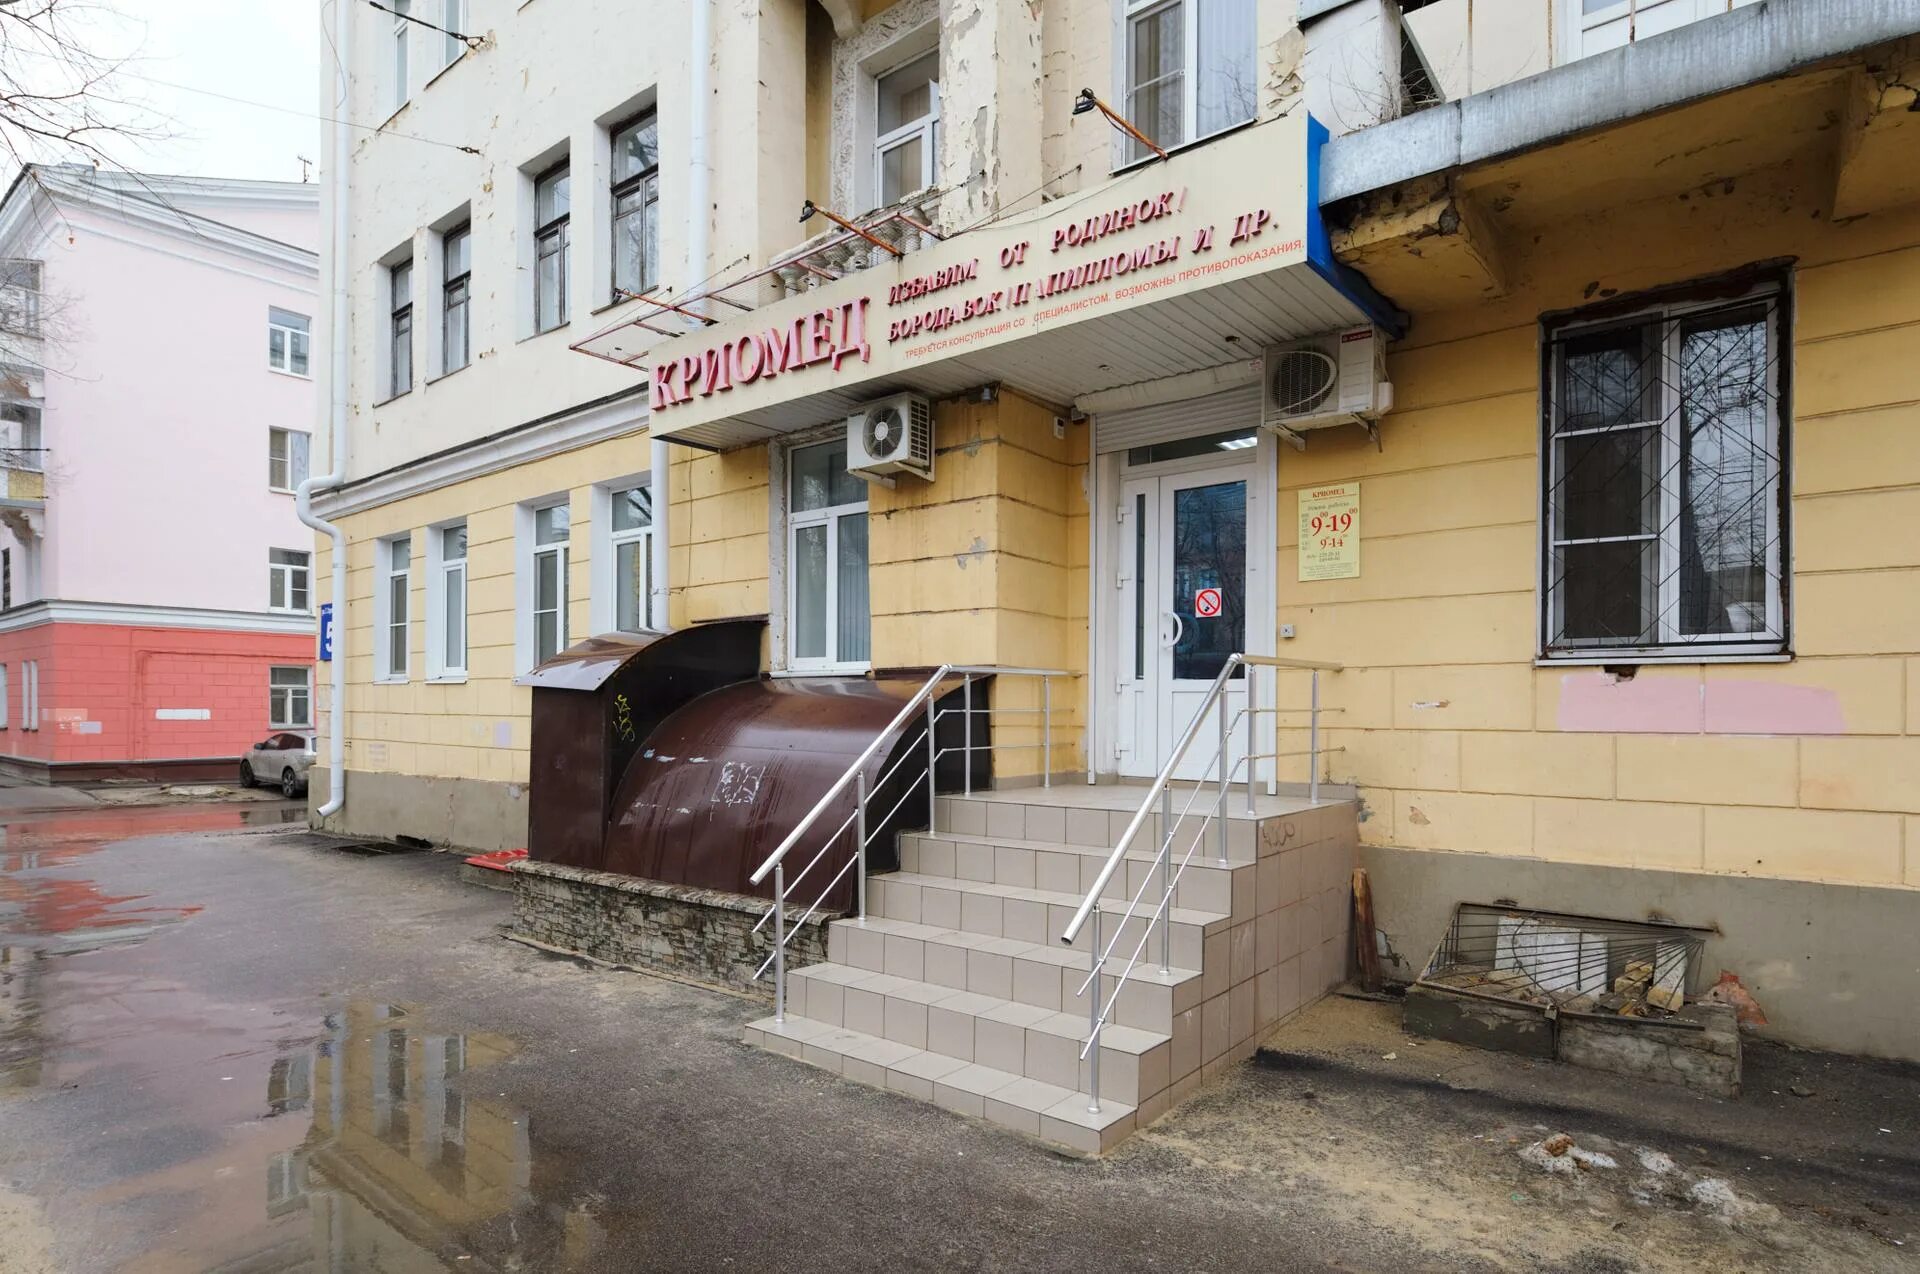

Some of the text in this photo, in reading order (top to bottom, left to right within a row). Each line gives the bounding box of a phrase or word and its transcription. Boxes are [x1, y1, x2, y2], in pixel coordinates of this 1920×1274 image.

[1192, 225, 1215, 255] И
[1229, 209, 1279, 247] ДР.
[888, 257, 979, 307] ИЗБАВИМ
[999, 241, 1031, 269] ОТ
[650, 296, 872, 411] КРИОМЕД
[904, 341, 948, 359] ТРЕБУЕТСЯ
[948, 322, 1011, 346] КОНСУЛЬТАЦИЯ
[1013, 317, 1025, 328] СО
[1115, 275, 1176, 299] ВОЗМОЖНЫ
